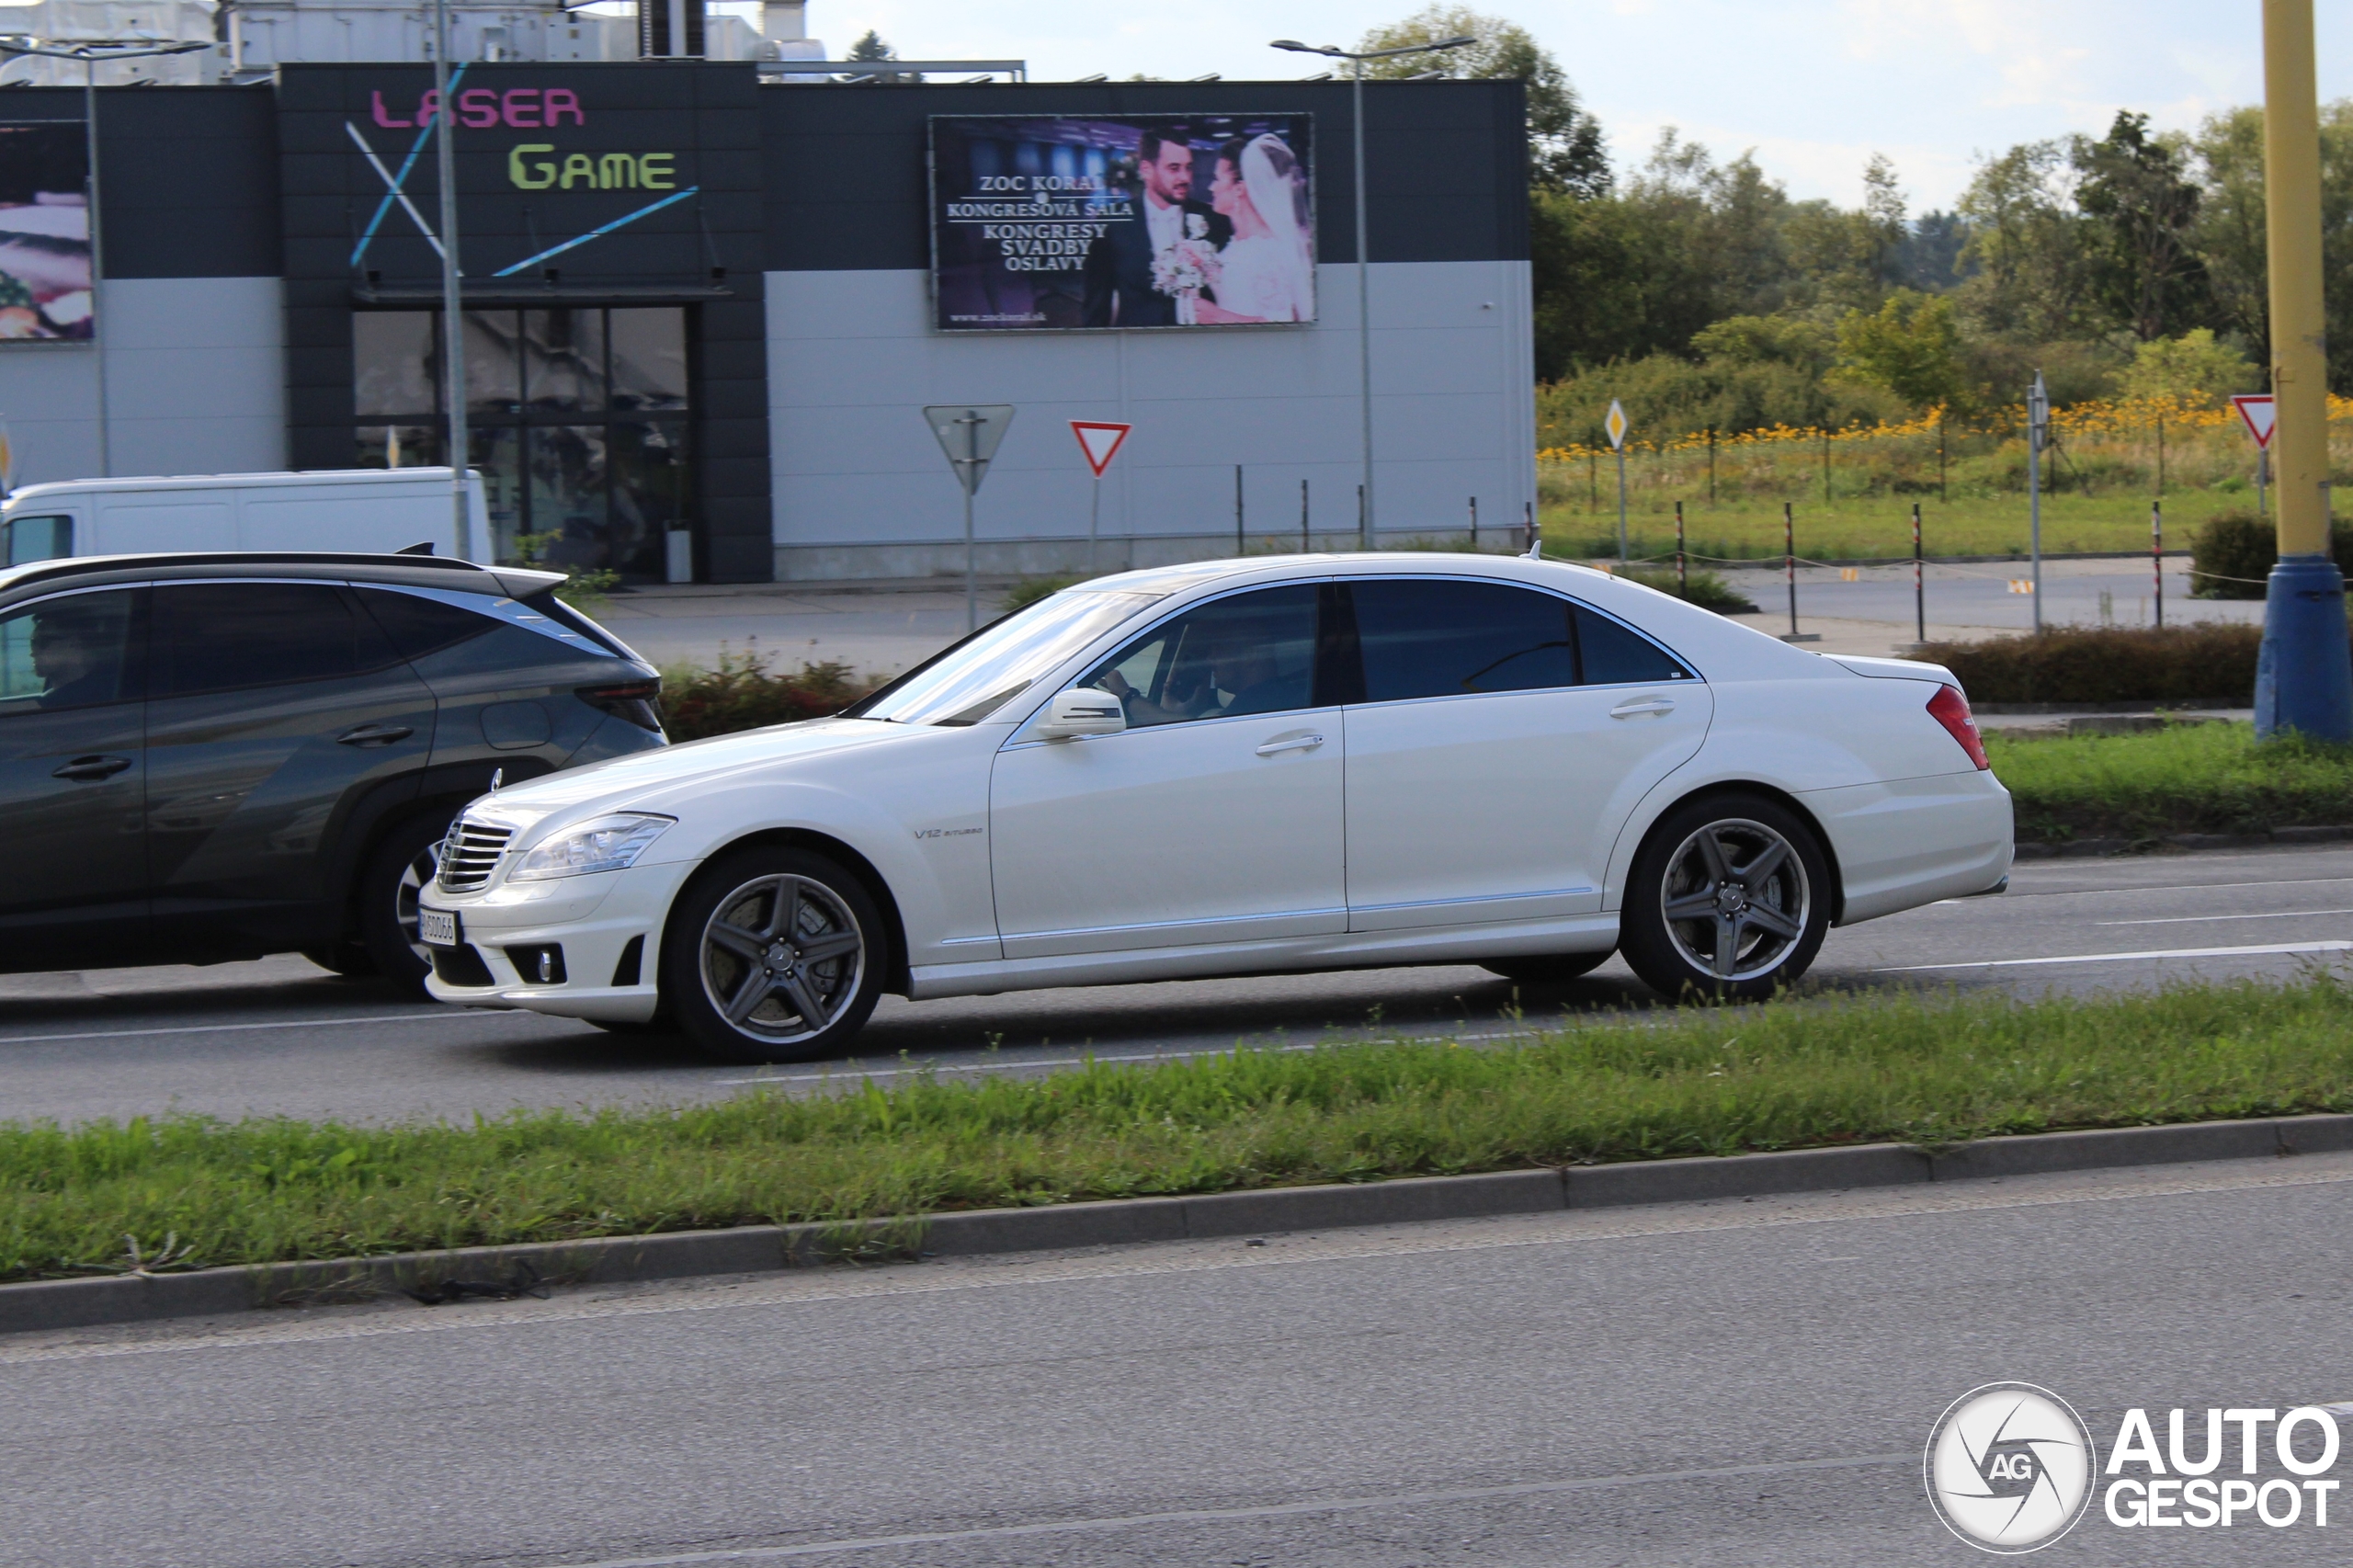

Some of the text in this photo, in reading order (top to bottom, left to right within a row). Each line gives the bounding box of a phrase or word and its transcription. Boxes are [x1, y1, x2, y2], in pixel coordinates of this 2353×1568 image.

[371, 89, 585, 128] LASER
[509, 144, 676, 189] GAME
[980, 176, 1104, 191] ZOC KORAL
[947, 199, 1080, 217] KONGRESOVÁ
[983, 224, 1108, 239] KONGRESY
[1000, 240, 1093, 256] SVADBY
[1005, 256, 1086, 271] OSLAVY
[914, 828, 941, 839] V12
